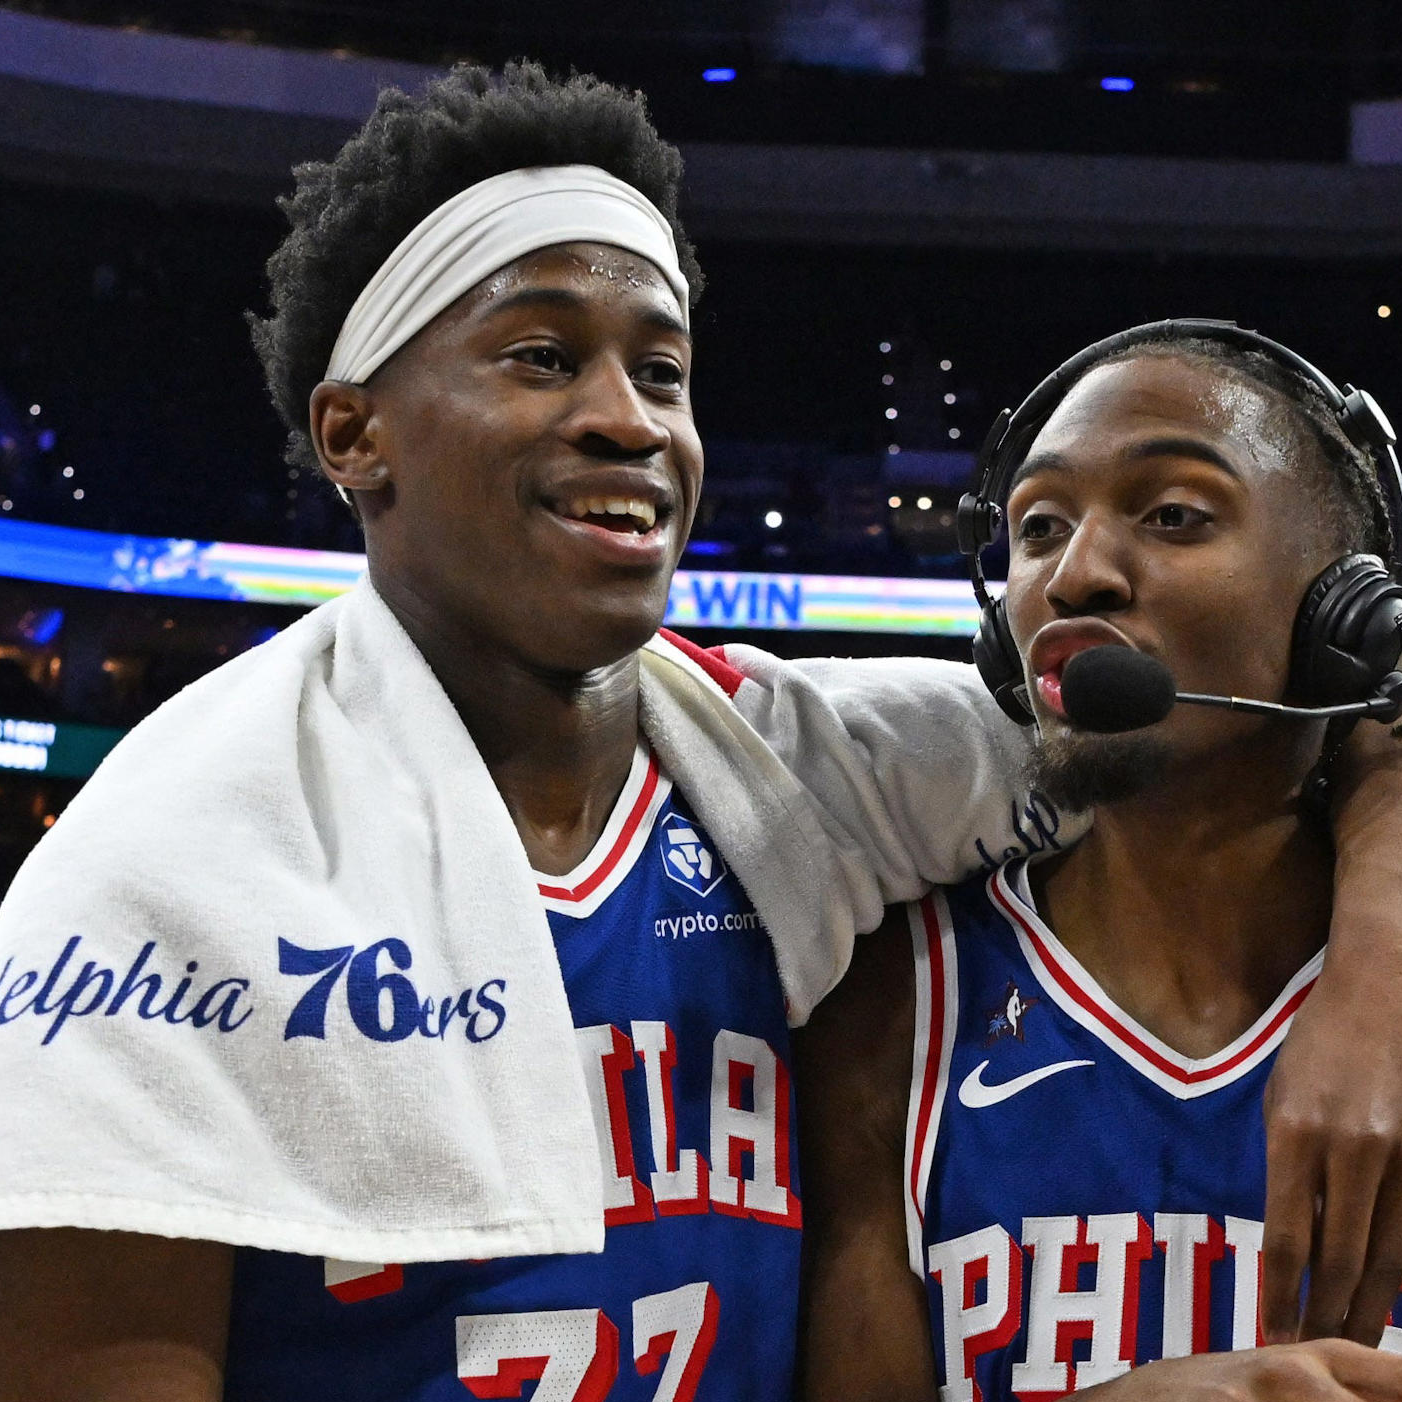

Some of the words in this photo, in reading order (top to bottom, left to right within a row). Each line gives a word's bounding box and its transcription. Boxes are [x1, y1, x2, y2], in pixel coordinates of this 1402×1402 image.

[691, 580, 801, 621] WIN
[655, 911, 767, 940] crypto.com
[277, 936, 507, 1043] 76ers
